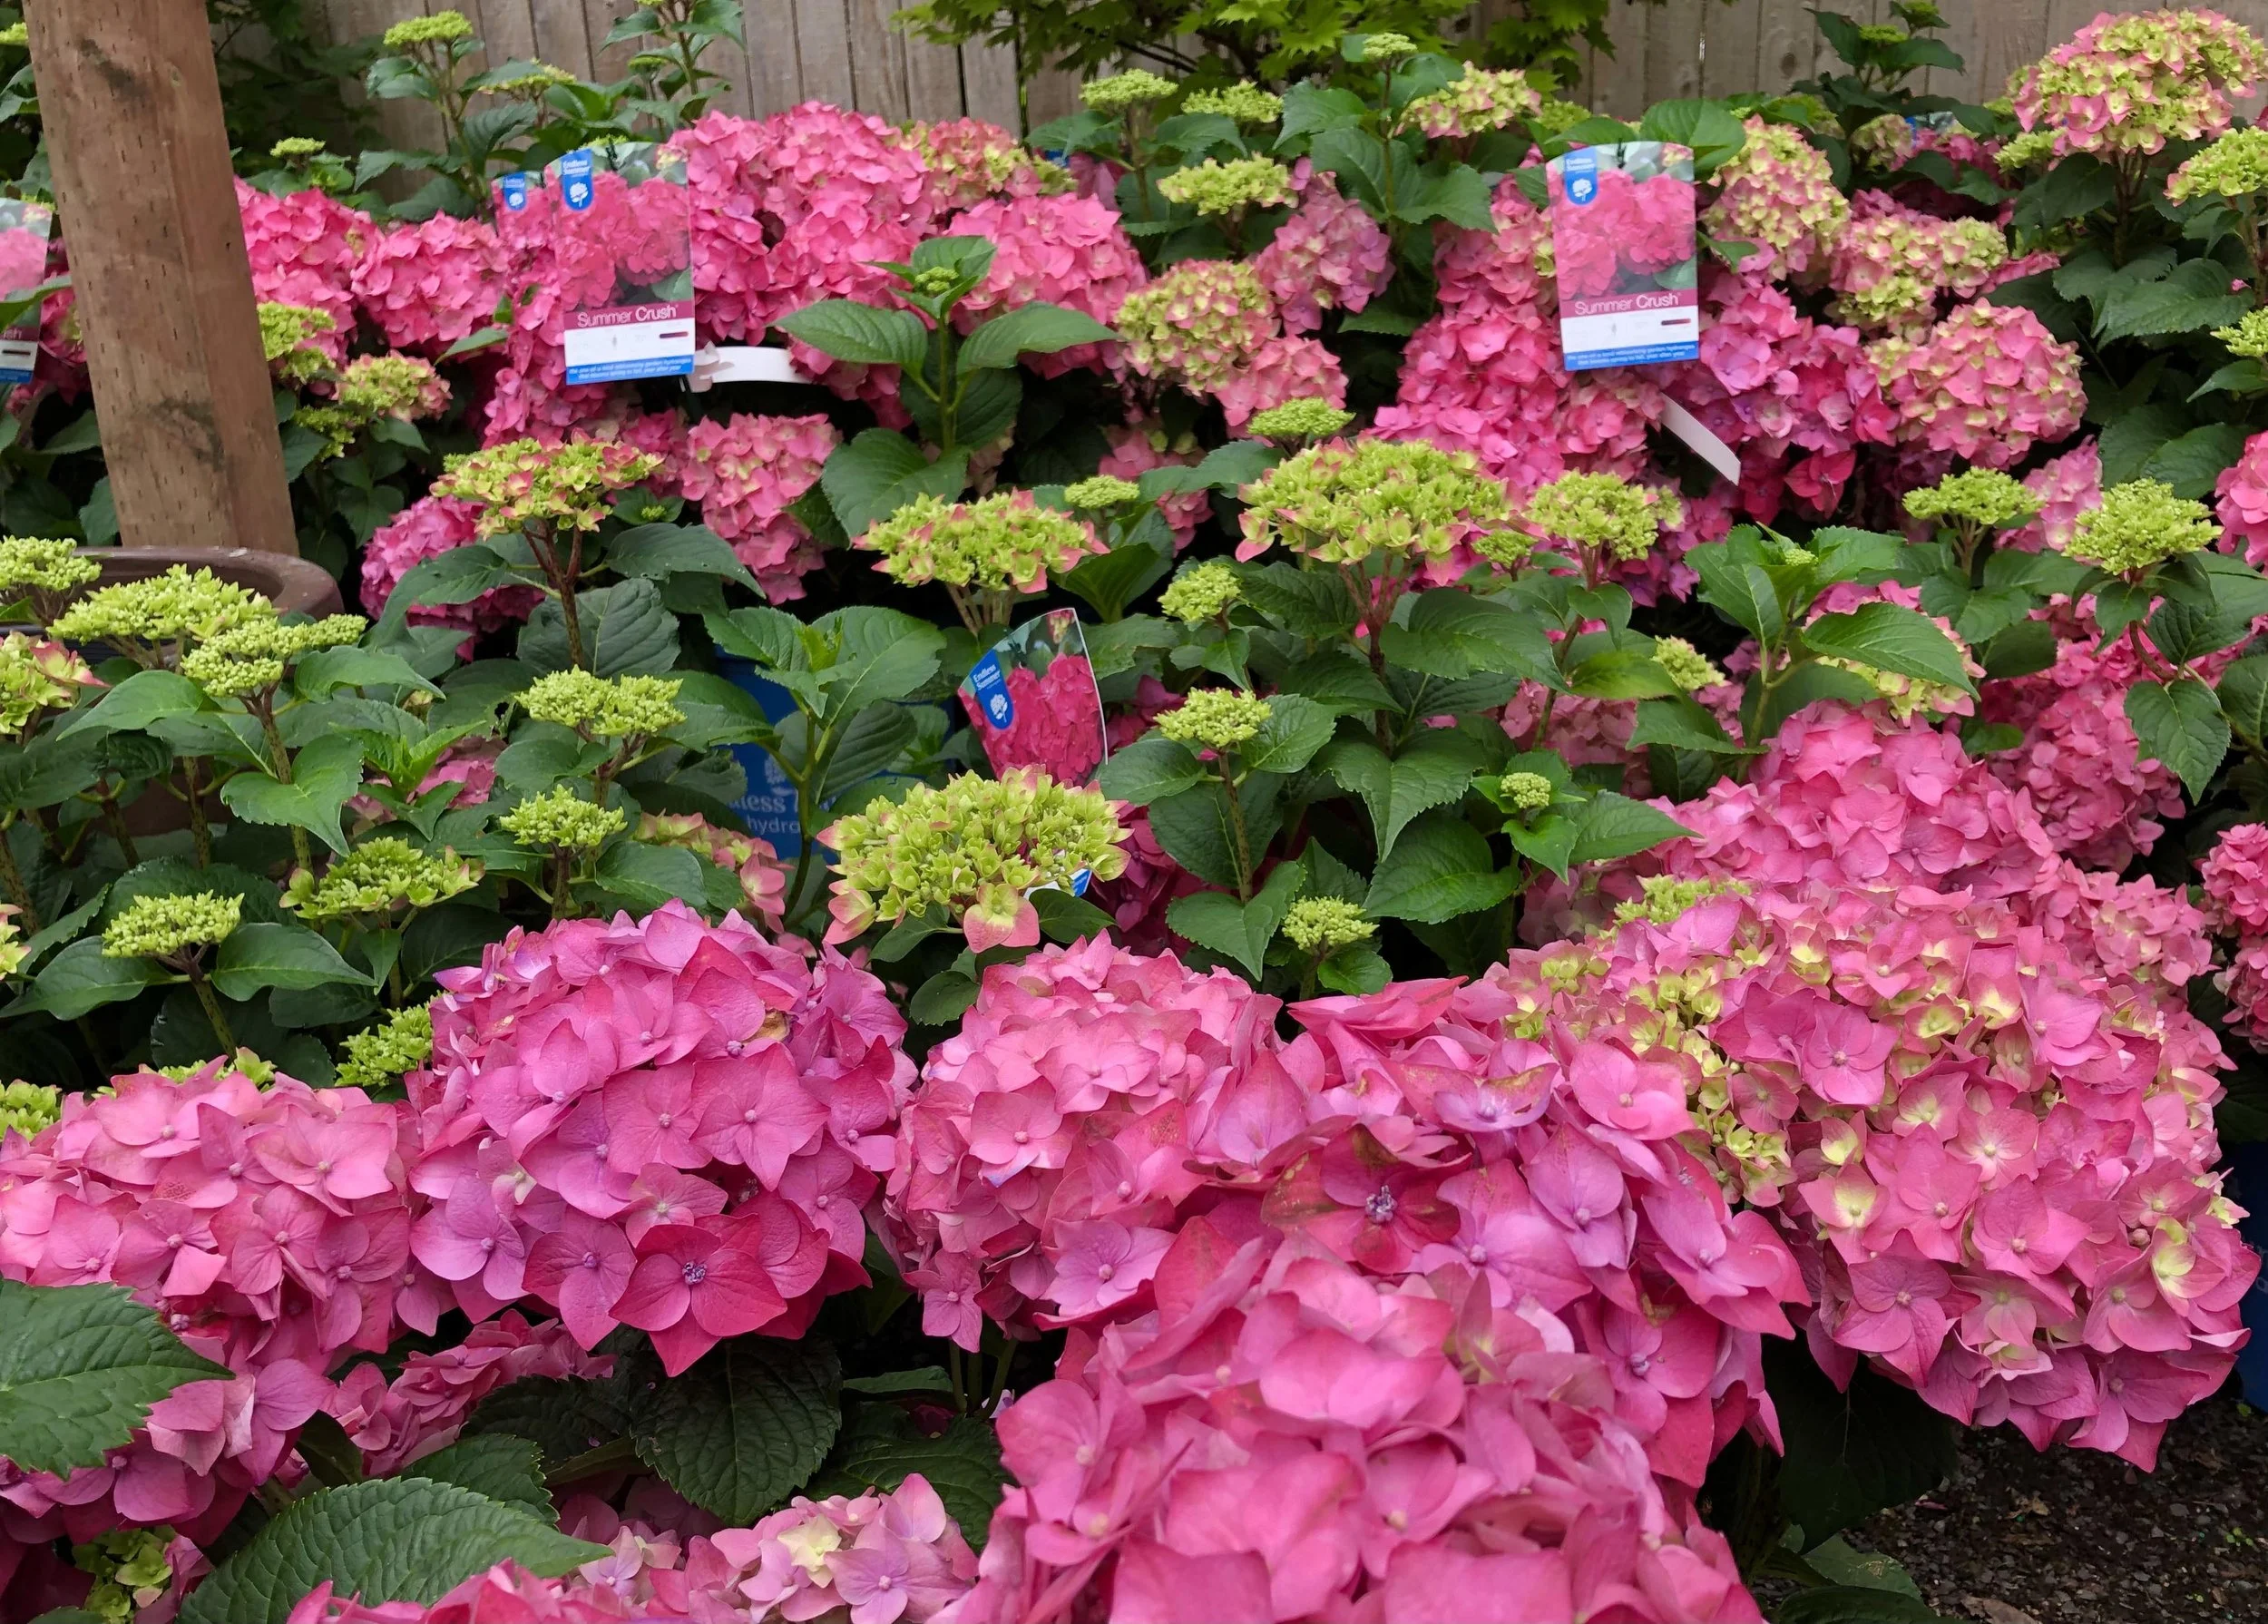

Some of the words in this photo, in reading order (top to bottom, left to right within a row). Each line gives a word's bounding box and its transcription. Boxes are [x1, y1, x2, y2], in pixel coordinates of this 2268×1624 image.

[1574, 298, 1633, 316] Summer
[1636, 293, 1678, 309] Crush
[577, 310, 633, 328] Summer
[635, 304, 677, 322] Crush
[729, 793, 787, 814] less
[747, 815, 801, 836] hydra
